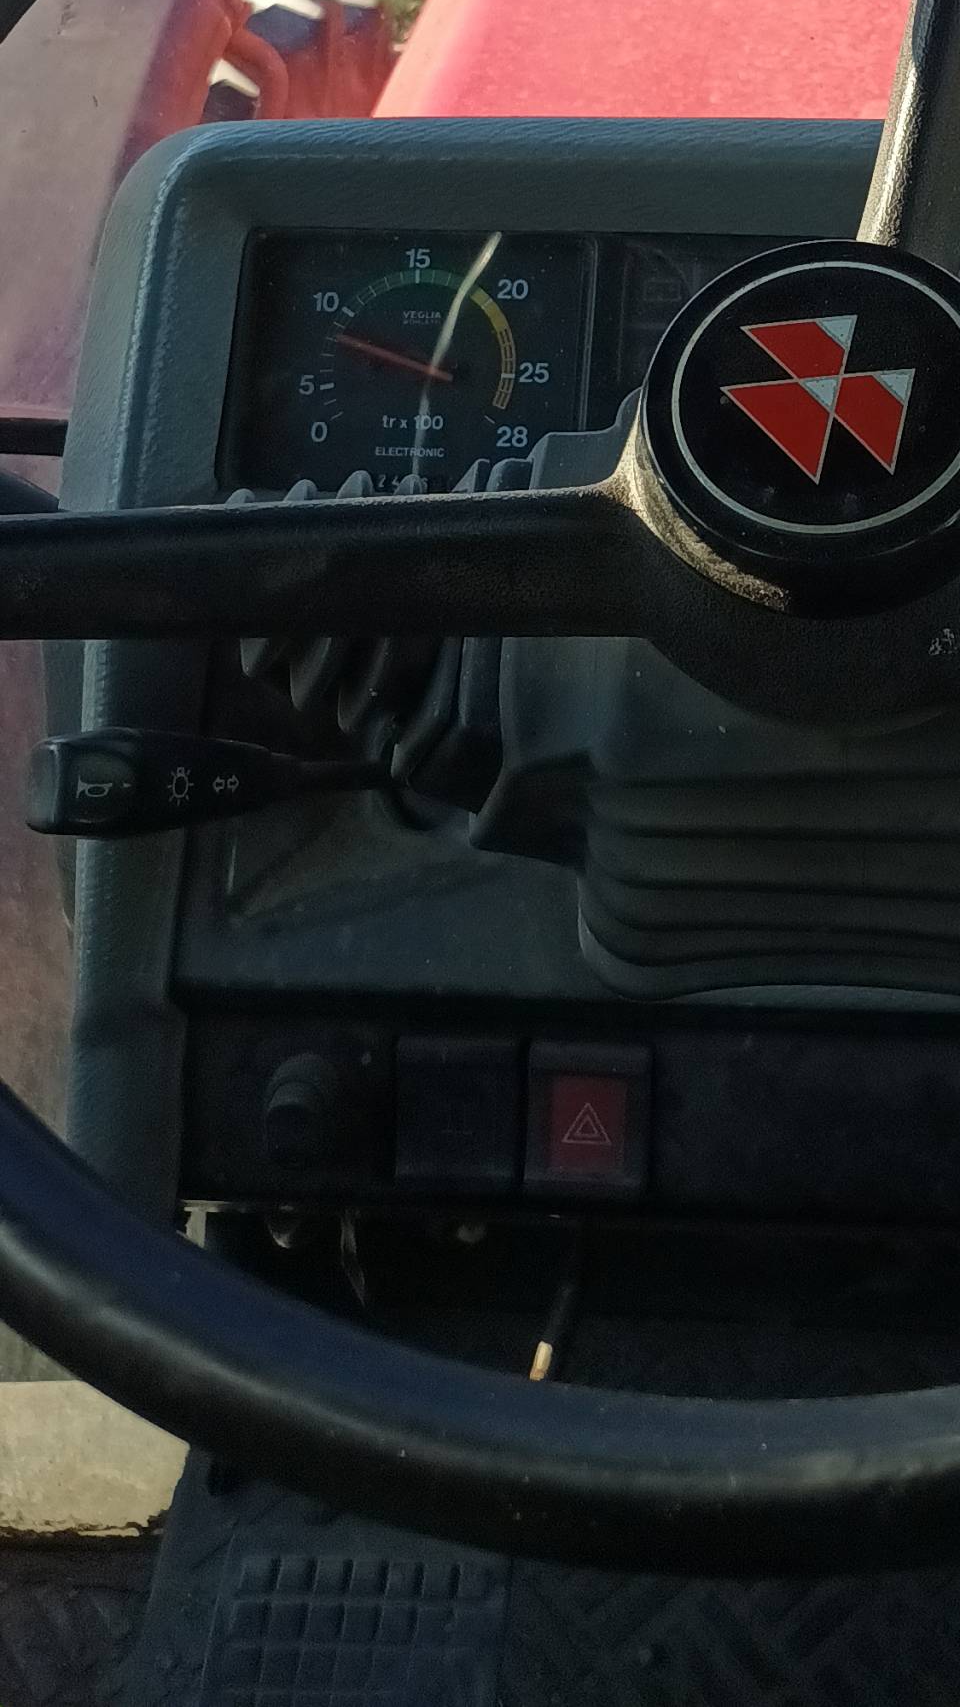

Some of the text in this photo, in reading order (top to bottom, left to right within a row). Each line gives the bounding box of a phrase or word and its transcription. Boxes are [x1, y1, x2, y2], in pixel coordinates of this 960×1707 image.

[405, 248, 431, 269] 15
[496, 278, 529, 300] 20
[313, 291, 340, 313] 10
[402, 310, 442, 319] VEGLIA
[518, 362, 550, 384] 25
[298, 374, 315, 396] 5
[310, 421, 328, 443] 0
[382, 414, 444, 431] tr x 100
[496, 425, 529, 447] 28
[374, 446, 445, 458] ELECTRONIC
